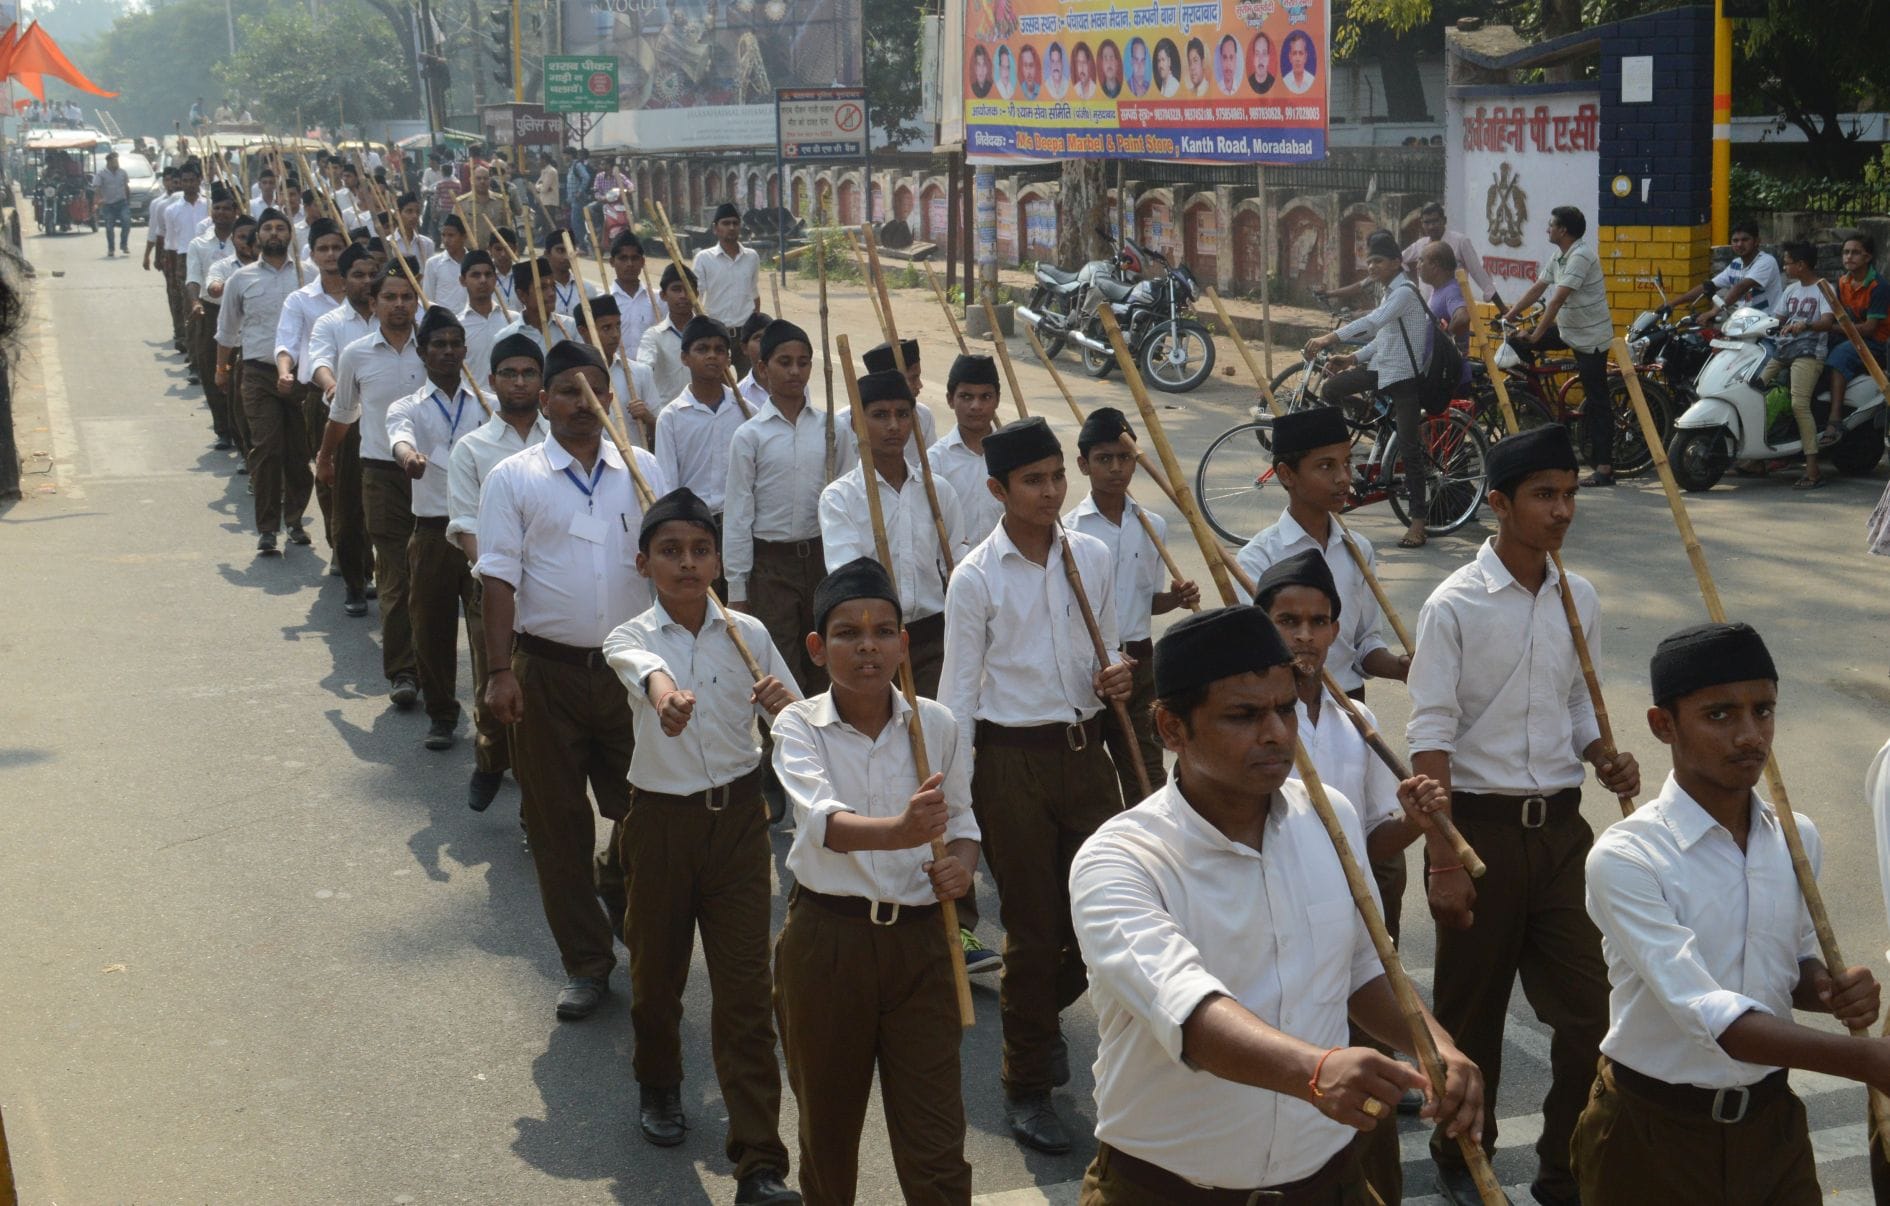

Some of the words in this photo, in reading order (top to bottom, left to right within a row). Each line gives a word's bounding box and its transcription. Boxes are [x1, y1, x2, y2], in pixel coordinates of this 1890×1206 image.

[1090, 13, 1108, 29] भवन
[1160, 7, 1176, 24] बाग
[516, 113, 544, 136] पुलिस
[1034, 132, 1065, 156] Deepa
[1067, 133, 1104, 152] Marbel
[1106, 133, 1115, 152] &
[1117, 133, 1145, 152] Paint
[1181, 135, 1214, 153] Kanth
[1217, 136, 1250, 156] Road,
[1253, 138, 1313, 155] Moradabad
[1482, 256, 1537, 283] मरादाबाद
